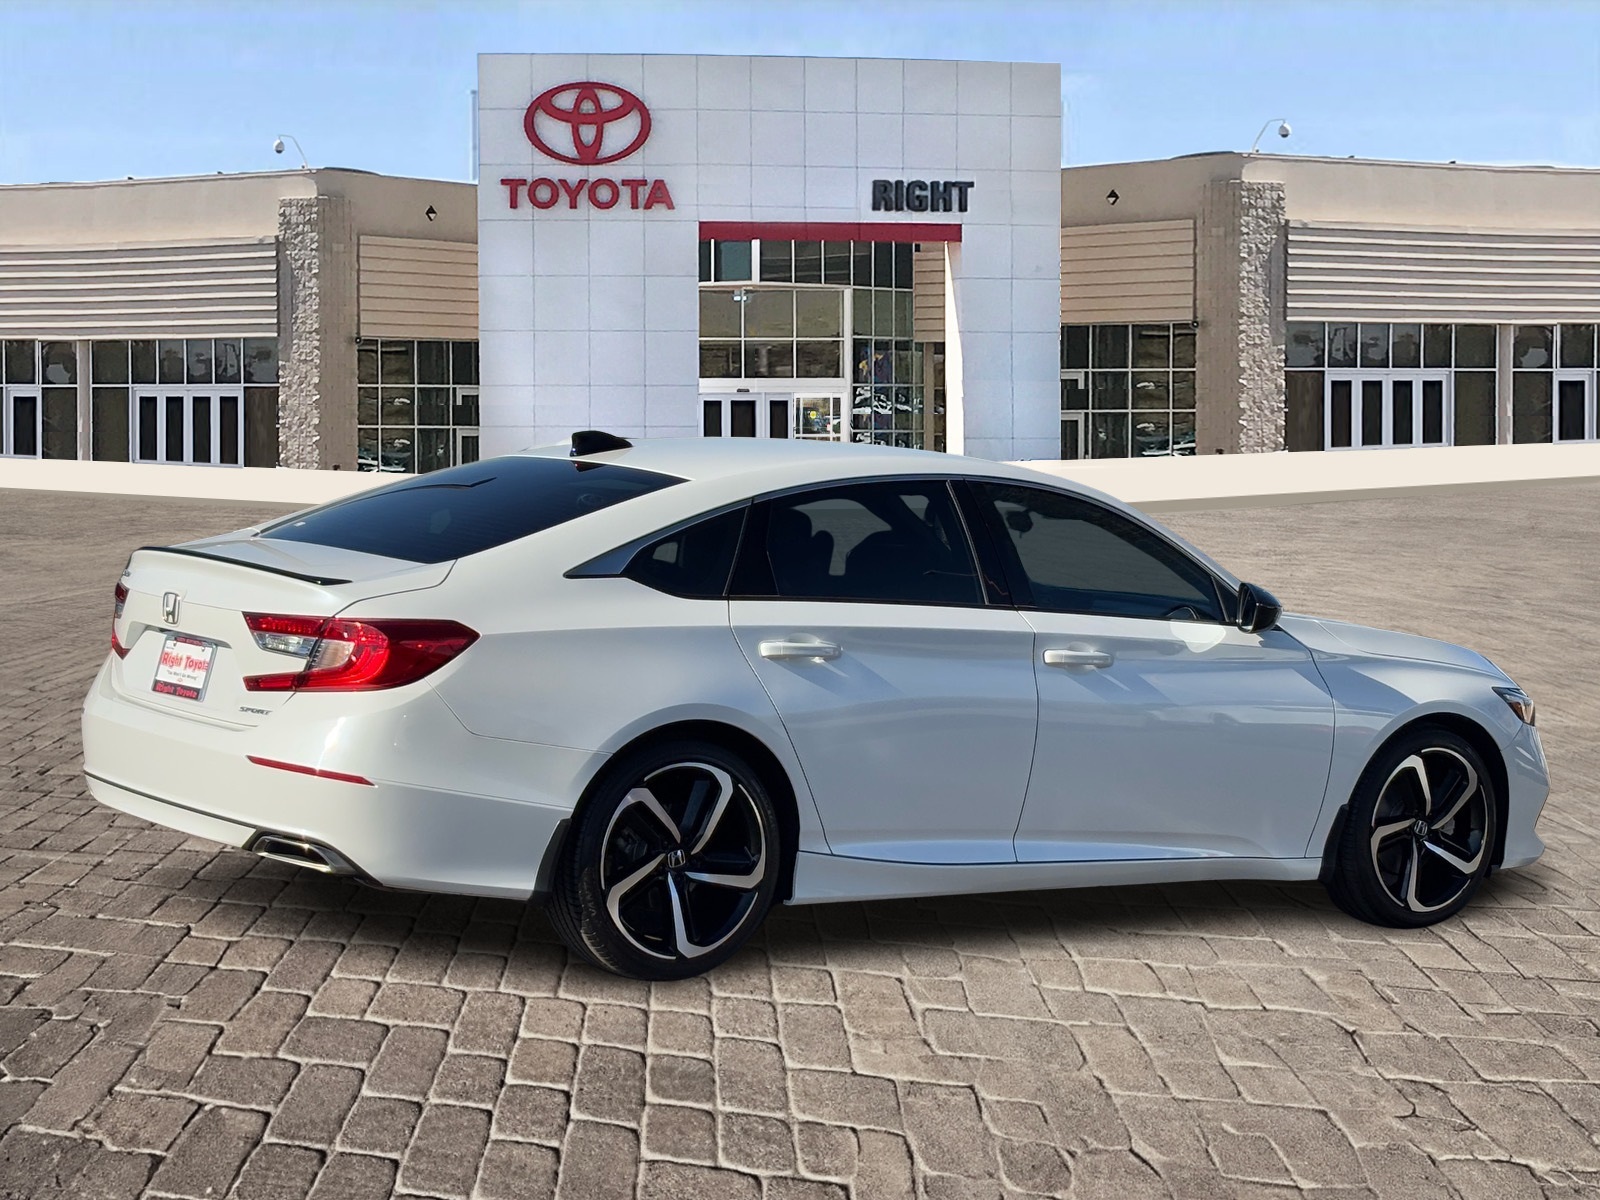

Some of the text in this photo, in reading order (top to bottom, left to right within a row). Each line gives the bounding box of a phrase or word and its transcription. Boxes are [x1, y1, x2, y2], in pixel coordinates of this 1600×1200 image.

[500, 178, 675, 210] TOYOTA
[872, 179, 975, 213] RIGHT
[162, 652, 182, 668] Right
[156, 682, 197, 698] Right Toyota
[239, 706, 273, 715] SPORT
